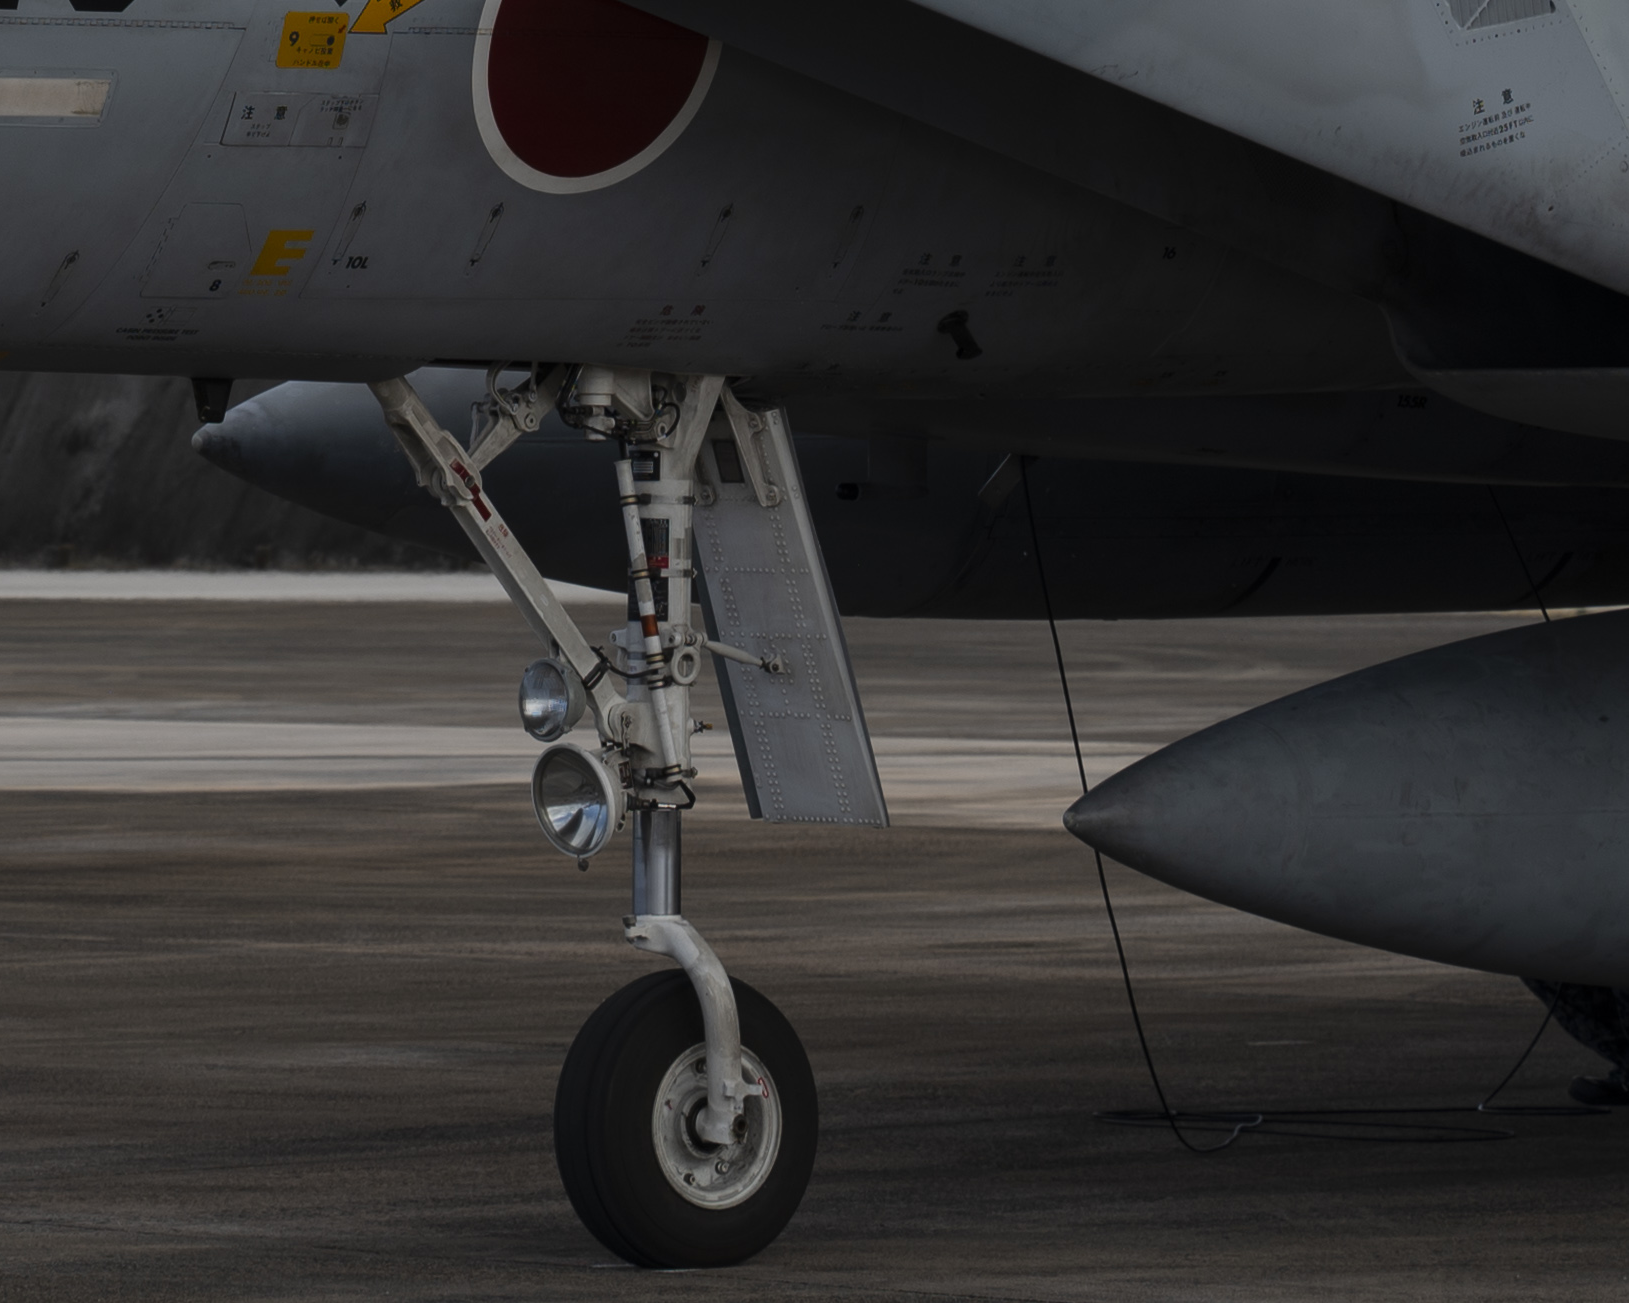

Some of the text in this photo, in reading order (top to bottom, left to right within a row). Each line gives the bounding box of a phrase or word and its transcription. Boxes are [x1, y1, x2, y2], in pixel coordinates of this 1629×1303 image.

[288, 30, 301, 47] 9
[1472, 88, 1514, 116] 注意
[241, 105, 288, 121] 注意
[250, 229, 315, 276] E
[1162, 246, 1177, 260] 16
[344, 255, 369, 270] 10L
[208, 278, 222, 292] 8
